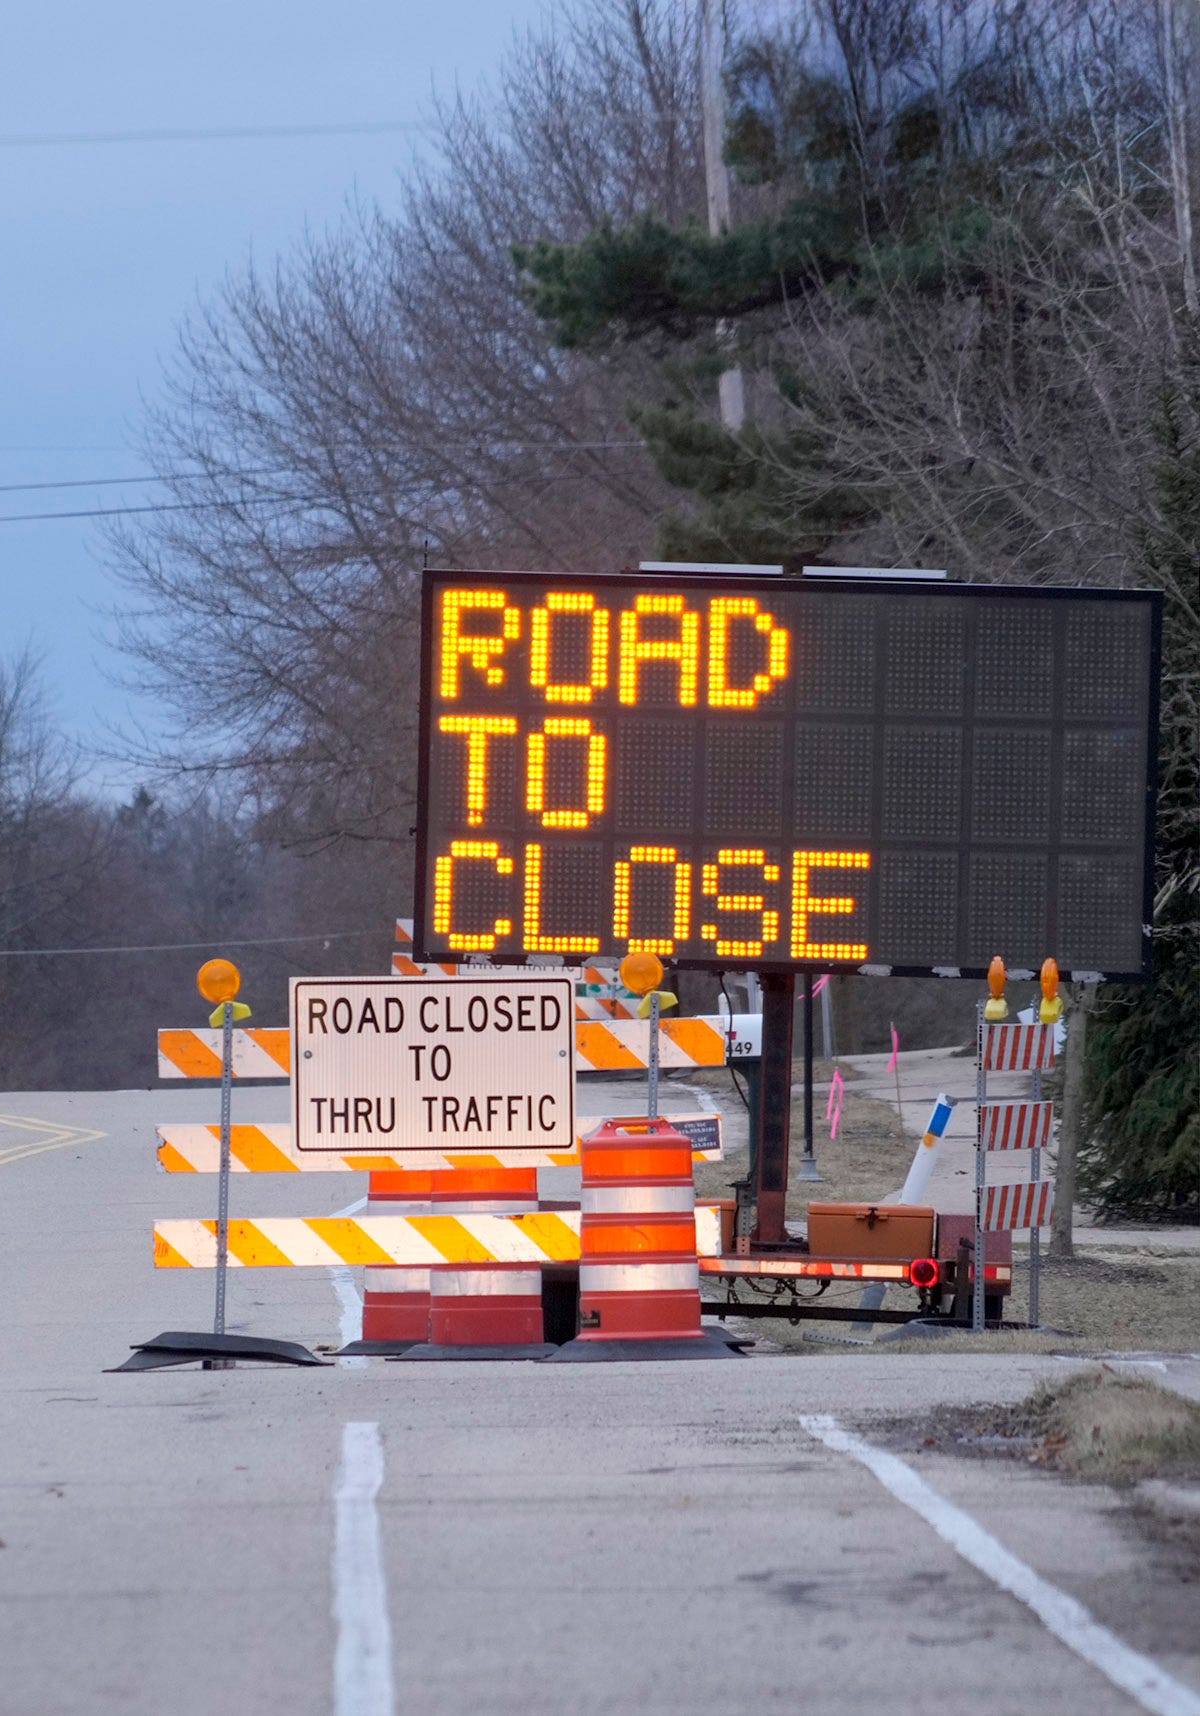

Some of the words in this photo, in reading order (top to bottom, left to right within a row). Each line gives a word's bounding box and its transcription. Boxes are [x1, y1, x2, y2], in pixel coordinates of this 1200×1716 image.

[440, 589, 789, 709] ROAD
[439, 715, 606, 830] TO
[434, 840, 871, 959] CLOSE
[308, 997, 405, 1035] ROAD
[419, 994, 561, 1033] CLOSED
[408, 1044, 451, 1082] TO
[310, 1096, 396, 1134] THRU
[422, 1094, 557, 1133] TRAFFIC
